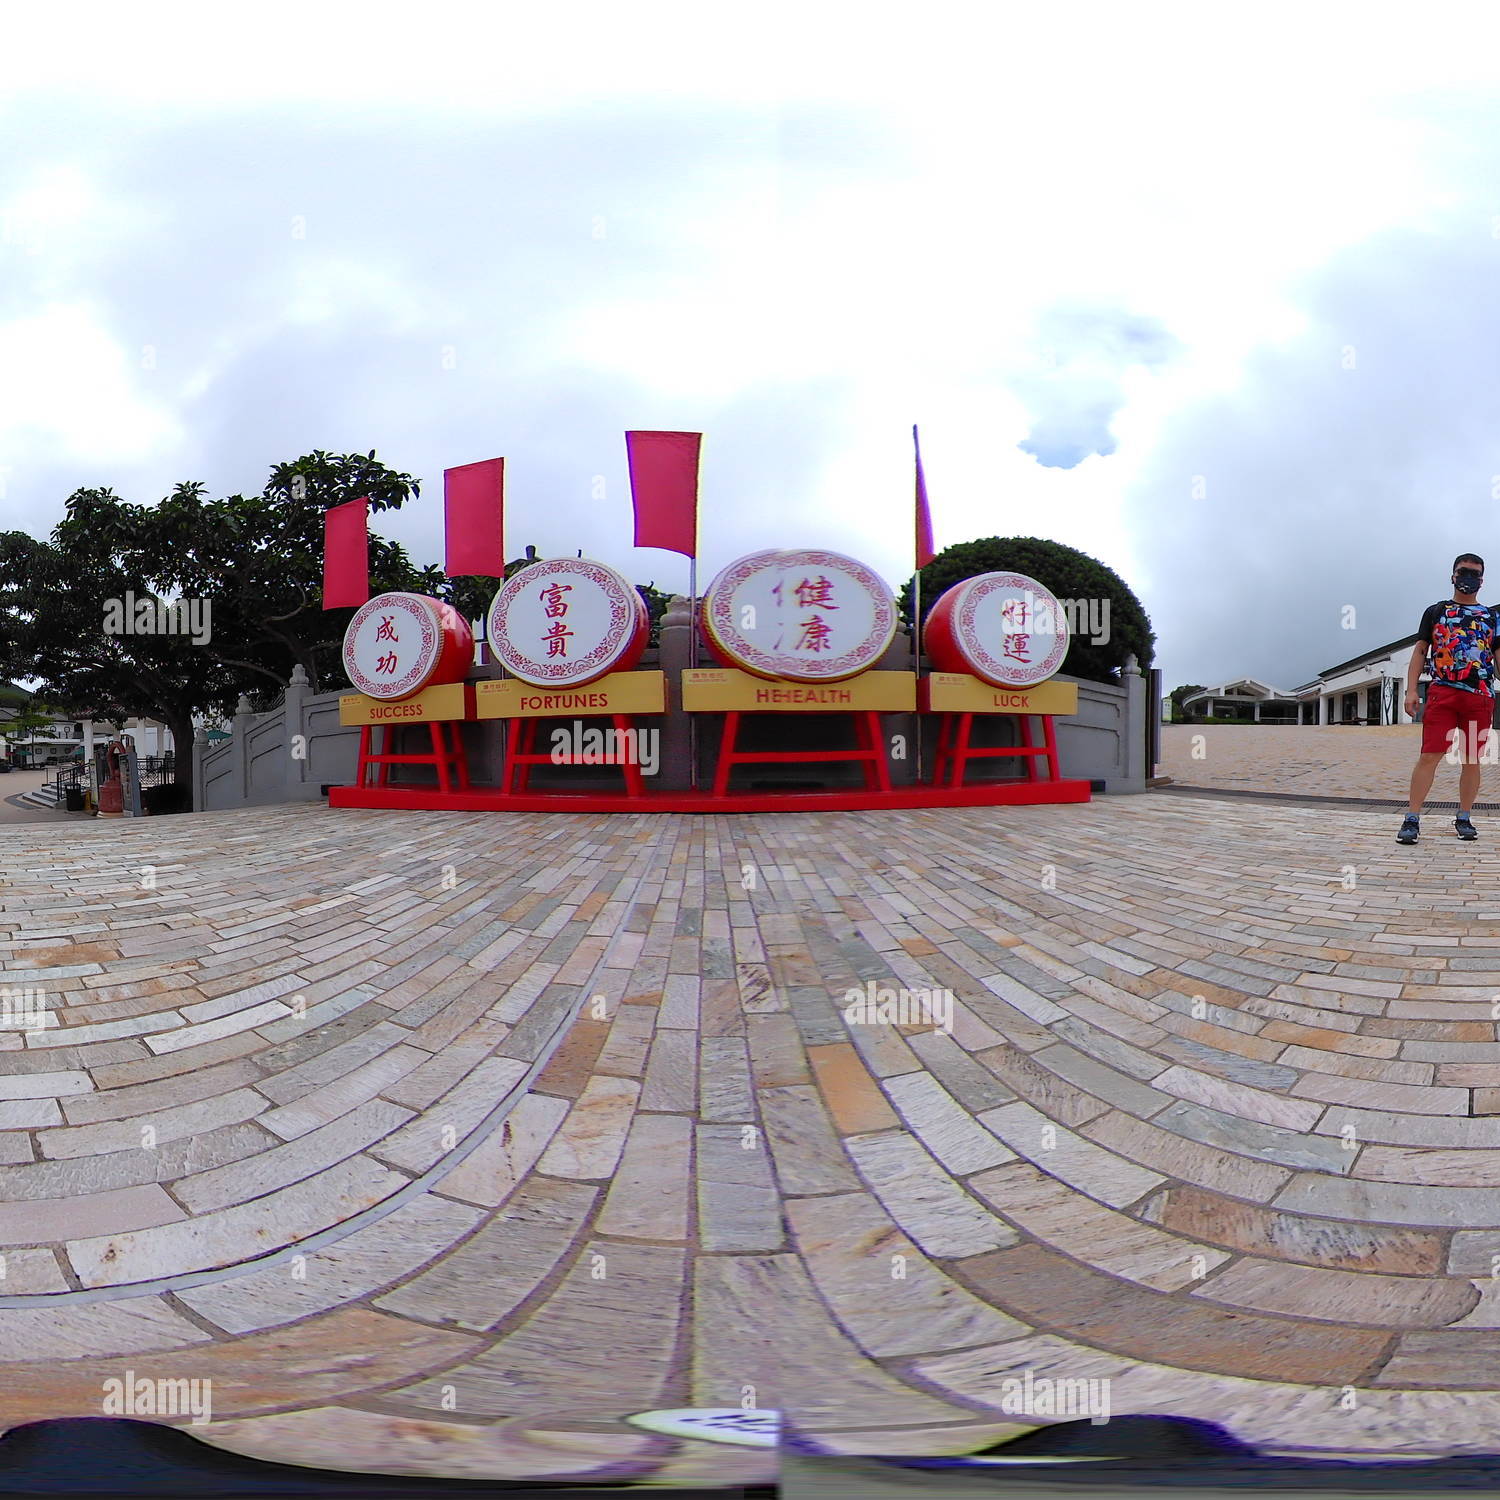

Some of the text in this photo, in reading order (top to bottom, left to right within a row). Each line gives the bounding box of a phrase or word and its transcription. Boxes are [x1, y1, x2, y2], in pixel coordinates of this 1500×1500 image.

[539, 582, 575, 658] 富貴
[794, 575, 840, 653] 健康
[1002, 601, 1032, 664] 好運
[375, 615, 399, 674] 成功
[369, 704, 423, 719] SUCCESS
[520, 693, 608, 710] FORTUNES
[993, 695, 1030, 708] LUCK
